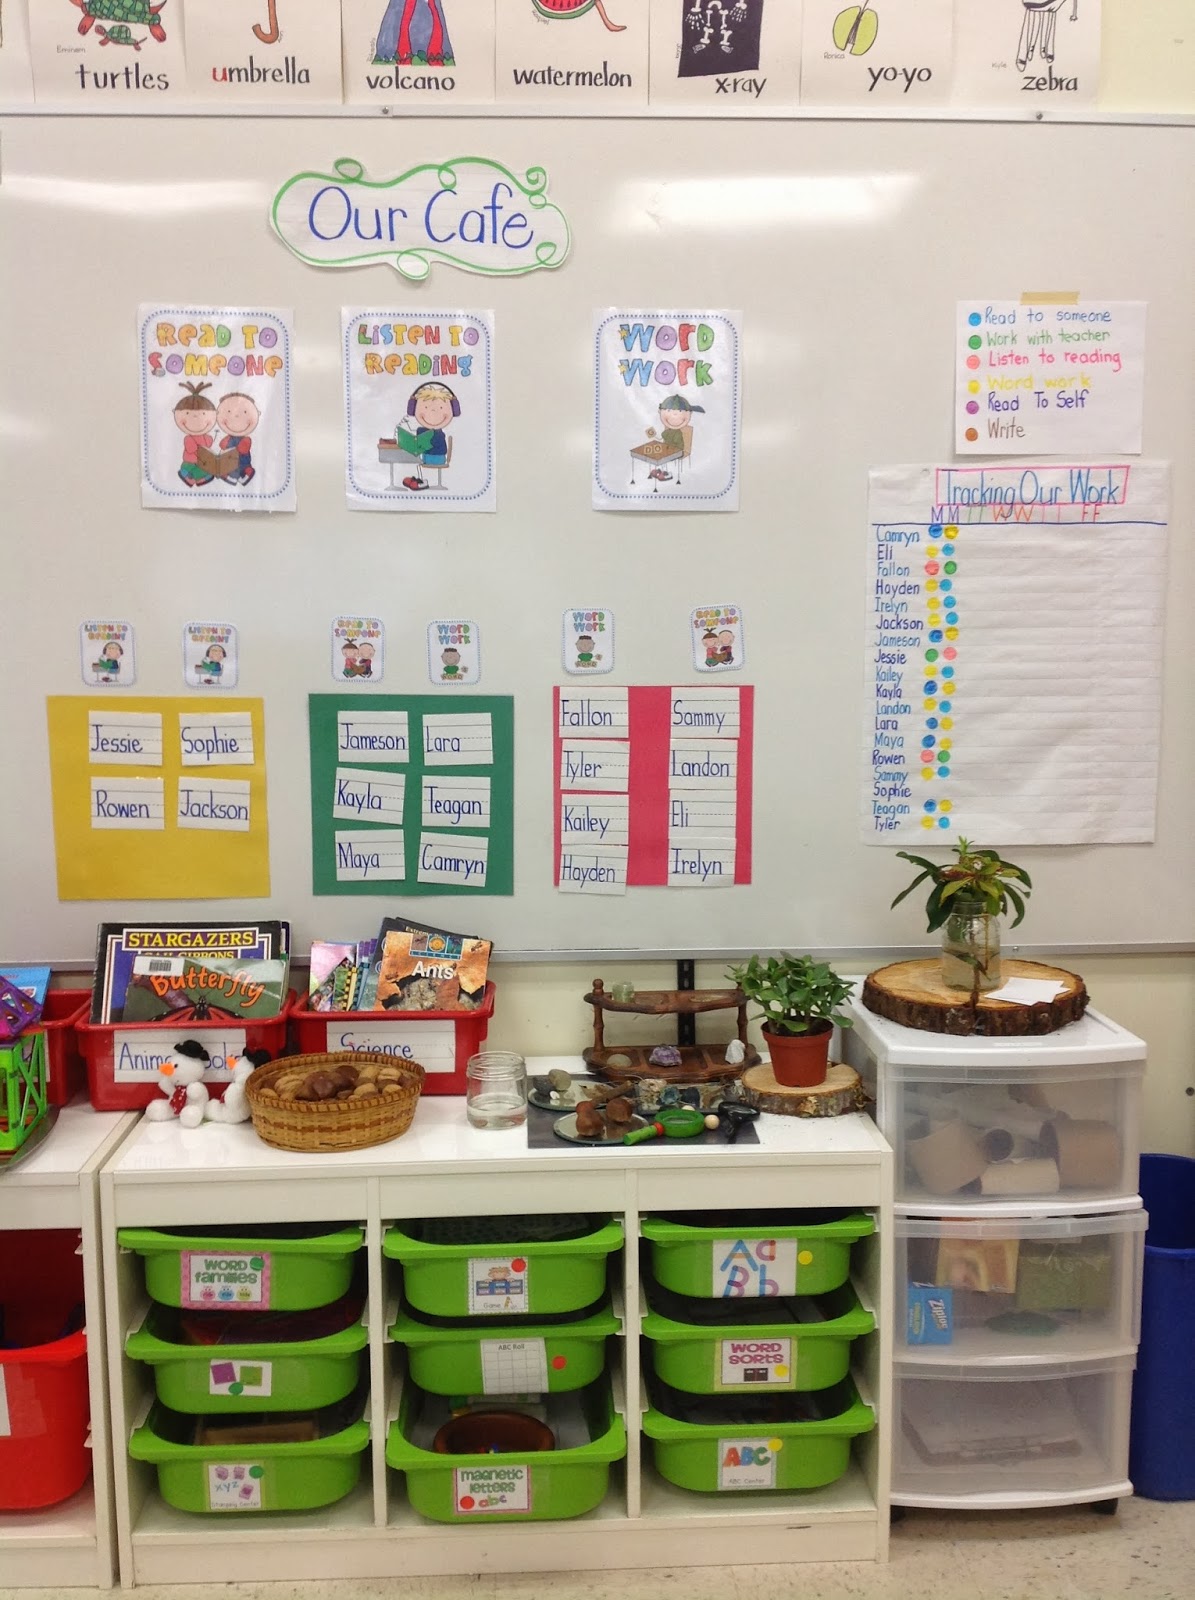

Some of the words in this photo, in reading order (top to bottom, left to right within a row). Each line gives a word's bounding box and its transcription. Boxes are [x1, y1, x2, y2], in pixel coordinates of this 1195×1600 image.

[75, 65, 169, 90] turtles
[212, 57, 310, 85] umbrella
[366, 67, 456, 90] volcano
[513, 61, 632, 89] watermelon
[867, 66, 931, 94] yo-yo
[1022, 68, 1077, 92] zebra
[715, 77, 766, 98] x-ray
[309, 186, 407, 240] Our
[425, 183, 533, 248] Cafe
[985, 307, 1015, 324] Read
[1027, 311, 1043, 322] to
[1057, 311, 1111, 322] someone
[243, 326, 277, 349] TO
[450, 326, 478, 346] TO
[987, 330, 1017, 346] Work
[1027, 332, 1052, 345] with
[1058, 330, 1110, 343] teacher
[989, 351, 1029, 366] Listen
[1039, 352, 1055, 364] to
[1065, 350, 1121, 372] reading
[987, 375, 1033, 390] Word
[1044, 374, 1091, 388] work
[988, 392, 1019, 411] Read
[1034, 392, 1048, 408] To
[1057, 389, 1089, 409] Self
[988, 417, 1025, 439] Write
[941, 470, 1016, 518] Tracking
[1020, 471, 1062, 504] Our
[1070, 470, 1119, 505] Work
[932, 507, 943, 523] M
[948, 507, 959, 523] M
[1014, 506, 1034, 521] W
[877, 529, 919, 547] Camryn
[877, 545, 892, 560] Eli
[877, 562, 909, 577] Fallon
[876, 579, 920, 597] Hayden
[875, 597, 907, 616] Irelyn
[876, 616, 923, 630] Jackson
[875, 634, 920, 647] Jameson
[875, 649, 907, 664] Jessie
[877, 667, 903, 684] Kailey
[876, 684, 902, 700] Kayla
[562, 699, 612, 726] Fallon
[673, 700, 725, 733] Sammy
[877, 702, 911, 714] Landon
[876, 718, 898, 730] Lara
[91, 724, 143, 753] Jessie
[182, 726, 239, 760] Sophie
[340, 723, 405, 750] Jameson
[426, 726, 460, 753] Lara
[875, 734, 904, 750] Maya
[563, 751, 601, 783] Tyler
[672, 750, 729, 777] Landon
[873, 750, 905, 765] Rowen
[874, 767, 908, 786] Sammy
[337, 779, 381, 814] Kayla
[874, 783, 911, 801] Sophie
[96, 790, 149, 818] Rowen
[180, 790, 248, 820] Jackson
[424, 786, 481, 824] Teagan
[672, 800, 688, 827] Eli
[872, 801, 909, 817] Teagan
[565, 806, 609, 839] Kailey
[874, 818, 900, 831] Tyler
[338, 842, 379, 877] Maya
[422, 844, 484, 879] Camryn
[672, 848, 722, 881] Irelyn
[562, 855, 615, 888] Hayden
[128, 932, 254, 948] STARGAZERS
[412, 961, 455, 979] Ants
[150, 966, 265, 1007] Butterfly
[341, 1032, 413, 1059] Science
[205, 1259, 247, 1270] WORD
[195, 1271, 258, 1284] families
[731, 1343, 782, 1354] WORD
[723, 1447, 771, 1467] ABC
[461, 1468, 523, 1481] magnetic
[478, 1494, 507, 1508] abc
